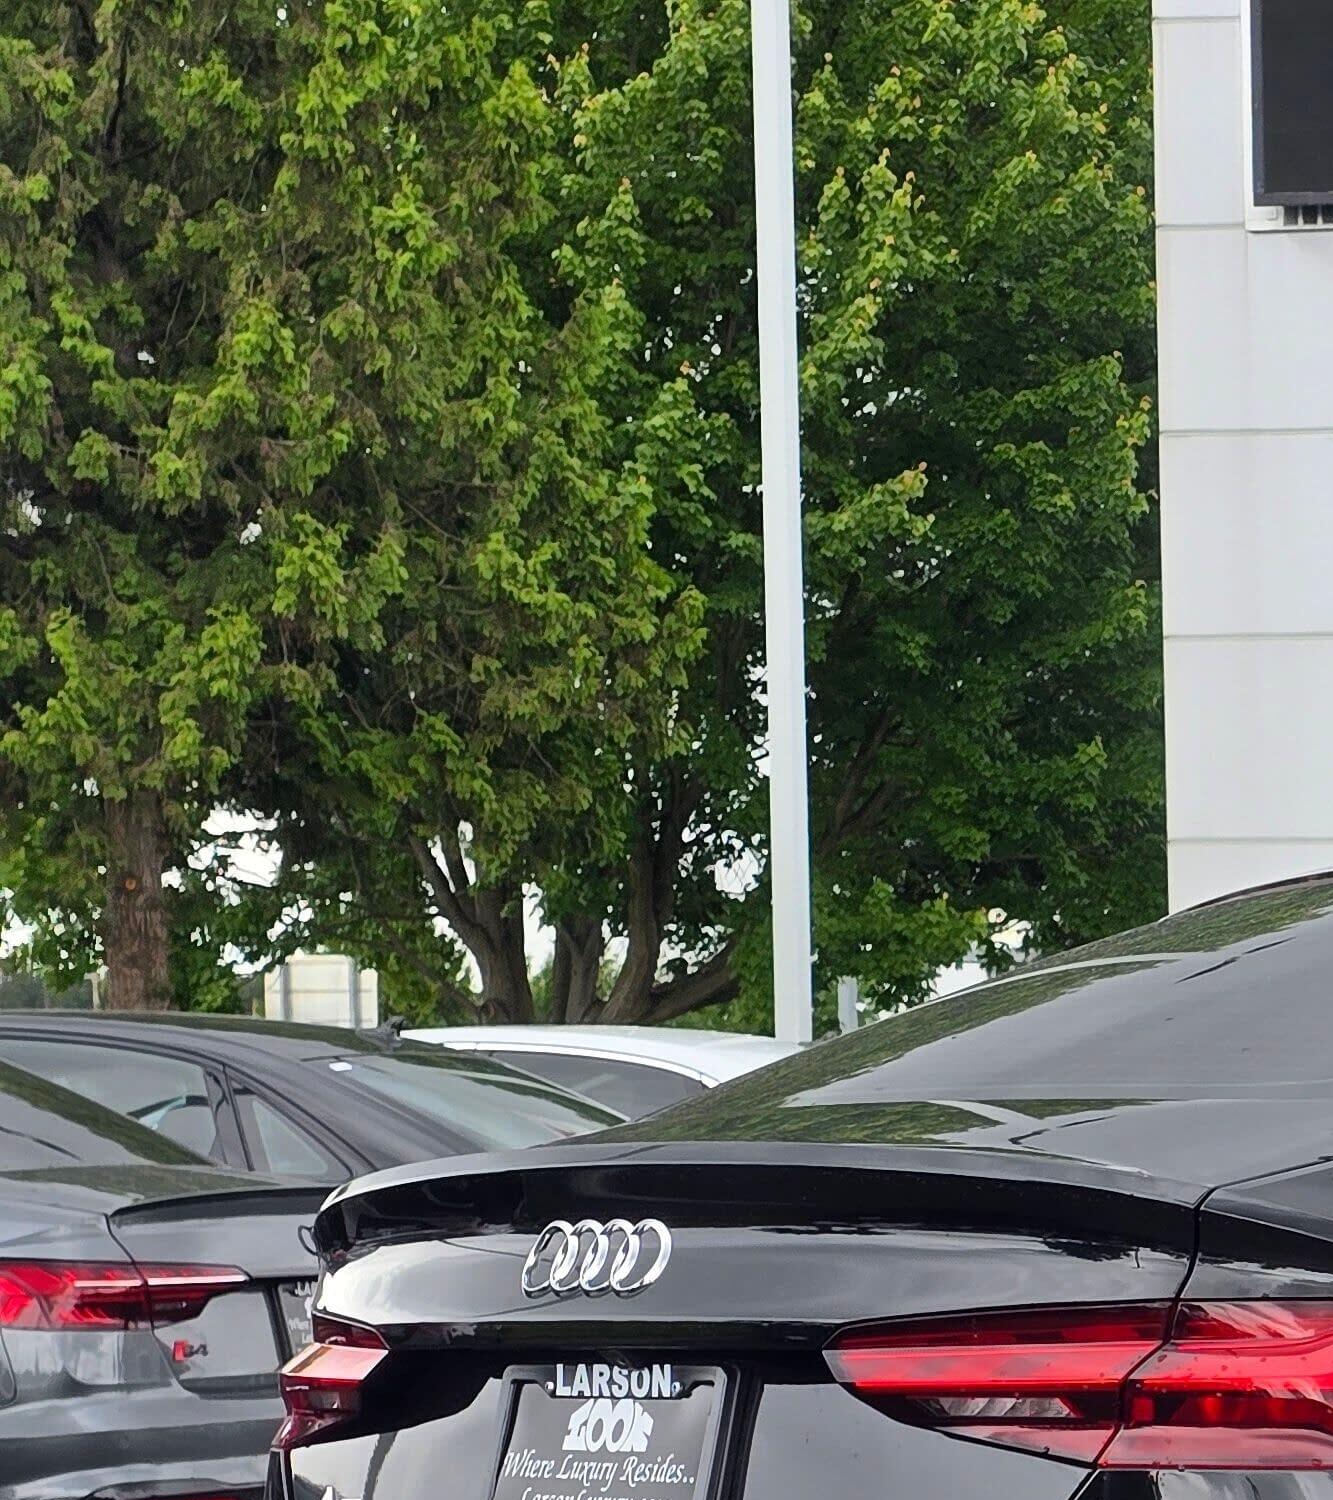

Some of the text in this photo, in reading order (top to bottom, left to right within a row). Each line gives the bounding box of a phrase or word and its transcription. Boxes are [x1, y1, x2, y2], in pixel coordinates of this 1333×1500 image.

[556, 1363, 672, 1398] LARSON
[504, 1449, 555, 1480] Where
[556, 1453, 617, 1492] Luxury
